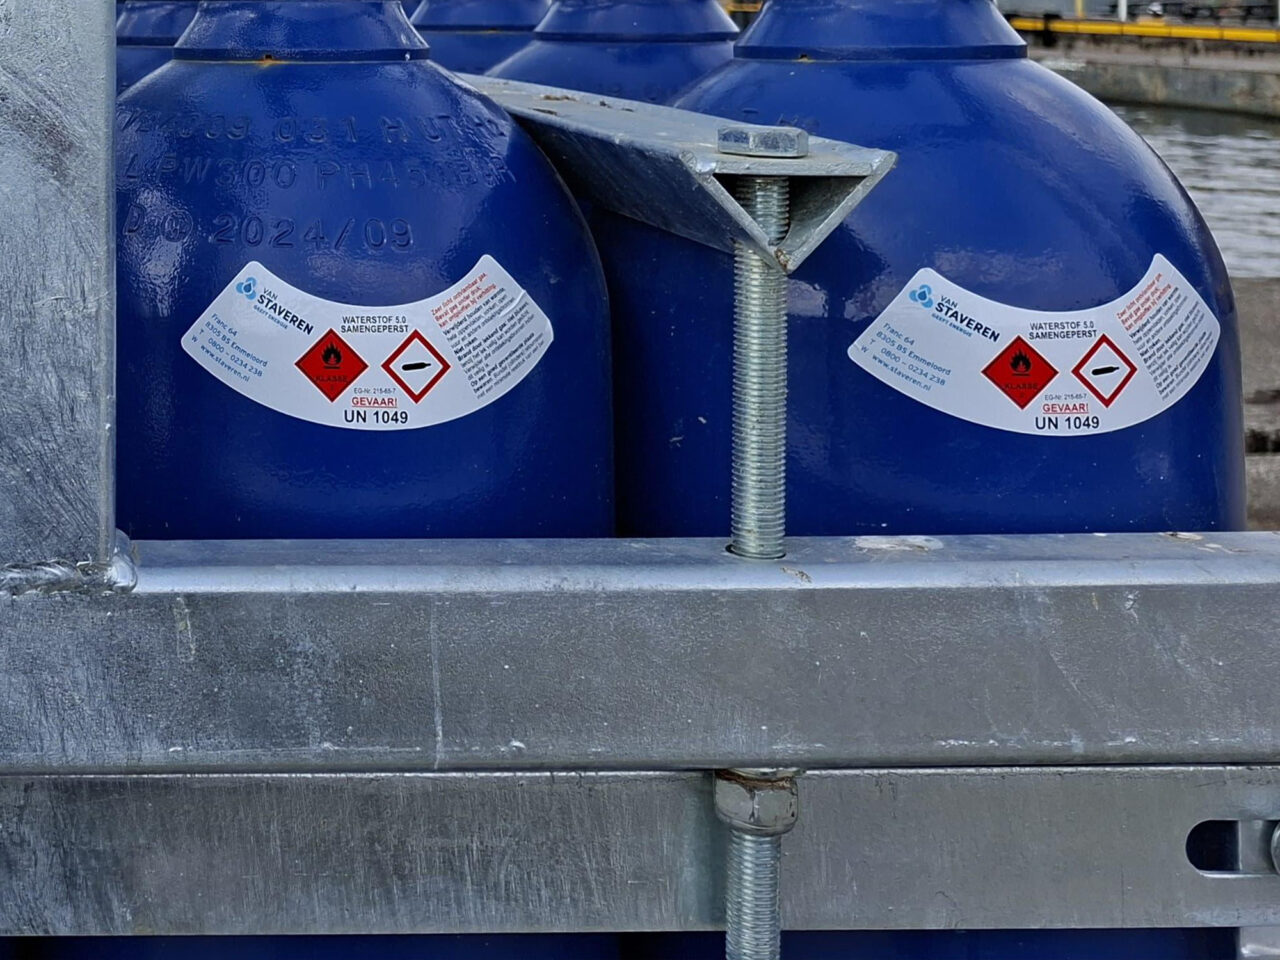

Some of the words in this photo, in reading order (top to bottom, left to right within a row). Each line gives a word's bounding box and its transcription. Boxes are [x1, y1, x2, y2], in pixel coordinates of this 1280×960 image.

[263, 288, 278, 300] VAN
[940, 296, 957, 307] VAN
[258, 295, 314, 335] STAVEREN
[342, 316, 393, 324] WATERSTOF
[341, 325, 409, 333] SAMENGEPERST
[936, 303, 1000, 342] STAVEREN
[1030, 321, 1080, 330] WATERSTOF
[228, 328, 237, 336] 64
[884, 323, 903, 340] Franc
[904, 337, 915, 345] 64
[1029, 330, 1097, 340] SAMENGEPERST
[206, 322, 221, 336] 8305
[222, 335, 230, 344] BS
[231, 342, 268, 367] Emmeloord
[208, 338, 224, 353] 0800
[231, 355, 248, 368] 0234
[249, 366, 262, 377] 238
[876, 331, 895, 346] 8305
[896, 344, 907, 353] BS
[908, 351, 951, 376] Emmeloord
[201, 345, 250, 382] www.staveren.nl
[881, 348, 900, 362] 0800
[908, 364, 928, 378] 0234
[929, 374, 945, 385] 238
[872, 355, 931, 391] www.staveren.nl
[352, 397, 397, 406] GEVAAR!
[1042, 404, 1089, 412] GEVAAR!
[344, 410, 367, 422] UN
[373, 411, 408, 424] 1049
[1036, 417, 1058, 430] UN
[1065, 416, 1099, 429] 1049
